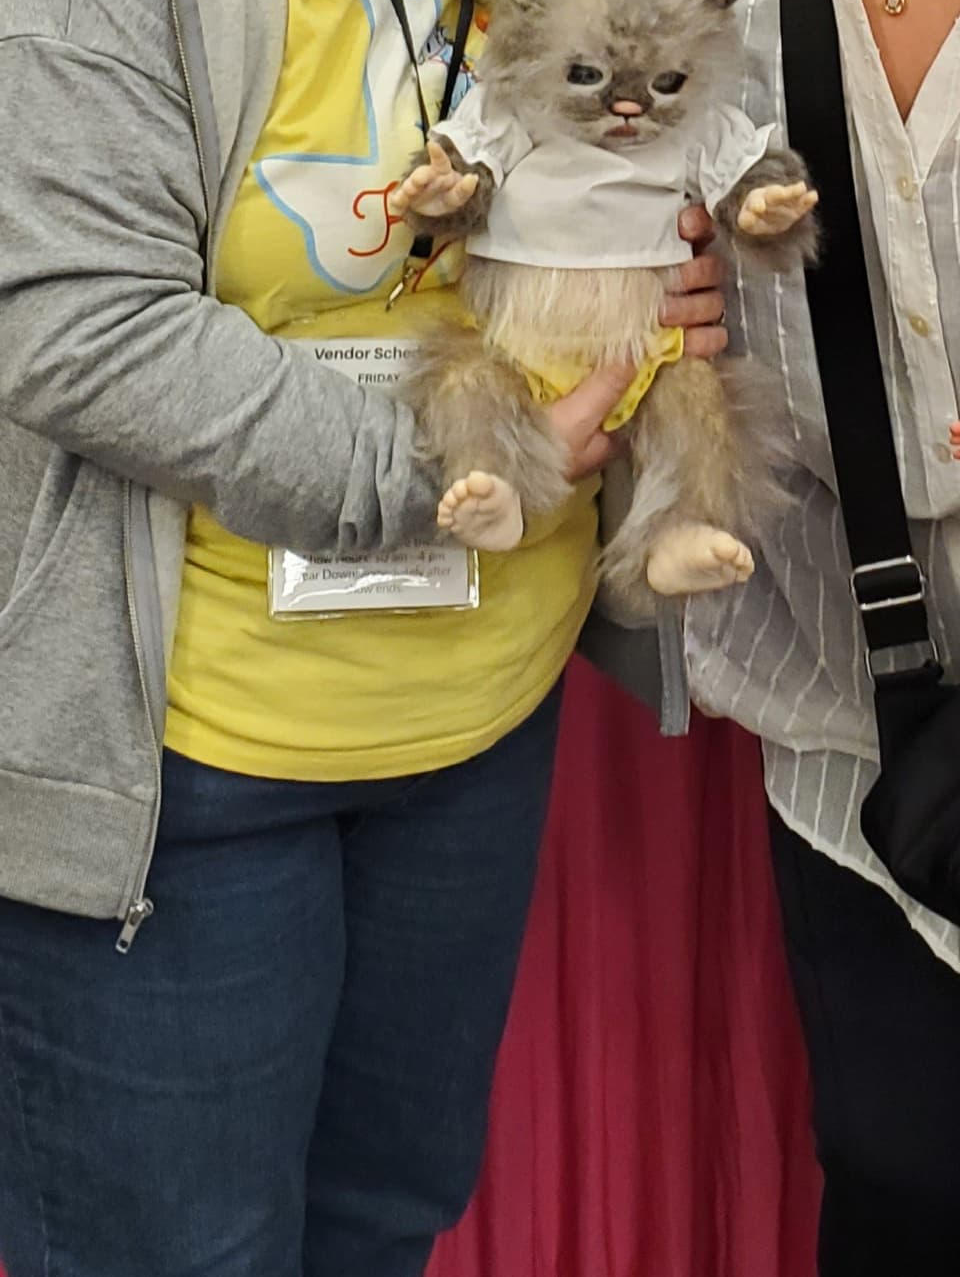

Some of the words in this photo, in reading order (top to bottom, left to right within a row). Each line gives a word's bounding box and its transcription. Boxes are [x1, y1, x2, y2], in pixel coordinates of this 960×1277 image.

[314, 348, 371, 361] Vendor
[357, 373, 401, 385] FRIDAY
[302, 571, 319, 581] ear
